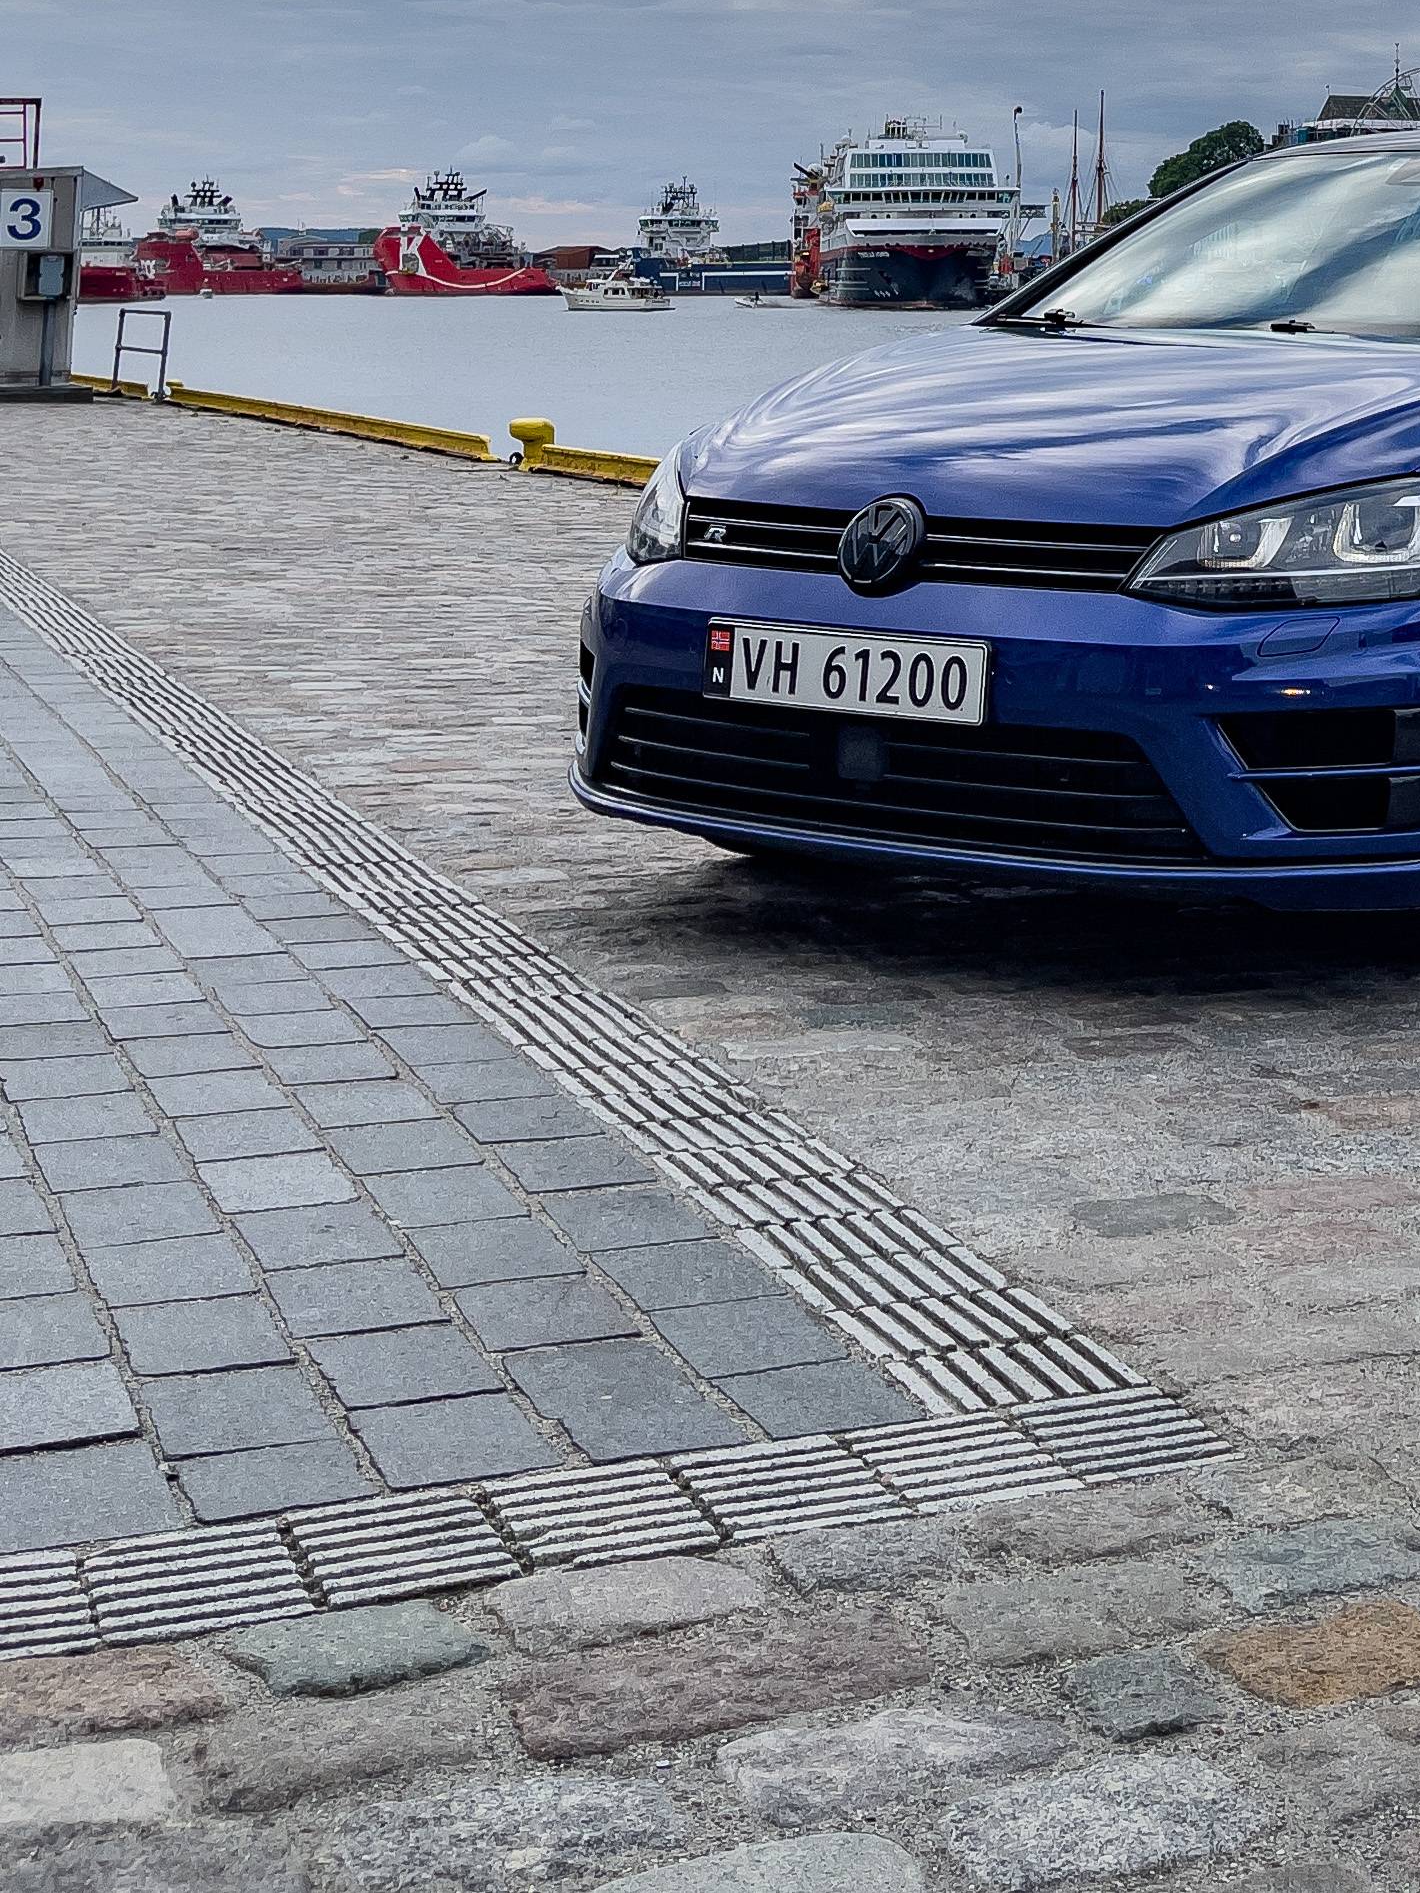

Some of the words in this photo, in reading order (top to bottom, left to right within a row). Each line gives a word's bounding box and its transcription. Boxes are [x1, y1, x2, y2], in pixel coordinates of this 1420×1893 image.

[7, 198, 42, 241] 3
[703, 523, 727, 543] R
[711, 666, 724, 684] N
[742, 637, 800, 695] VH
[822, 645, 968, 711] 61200
